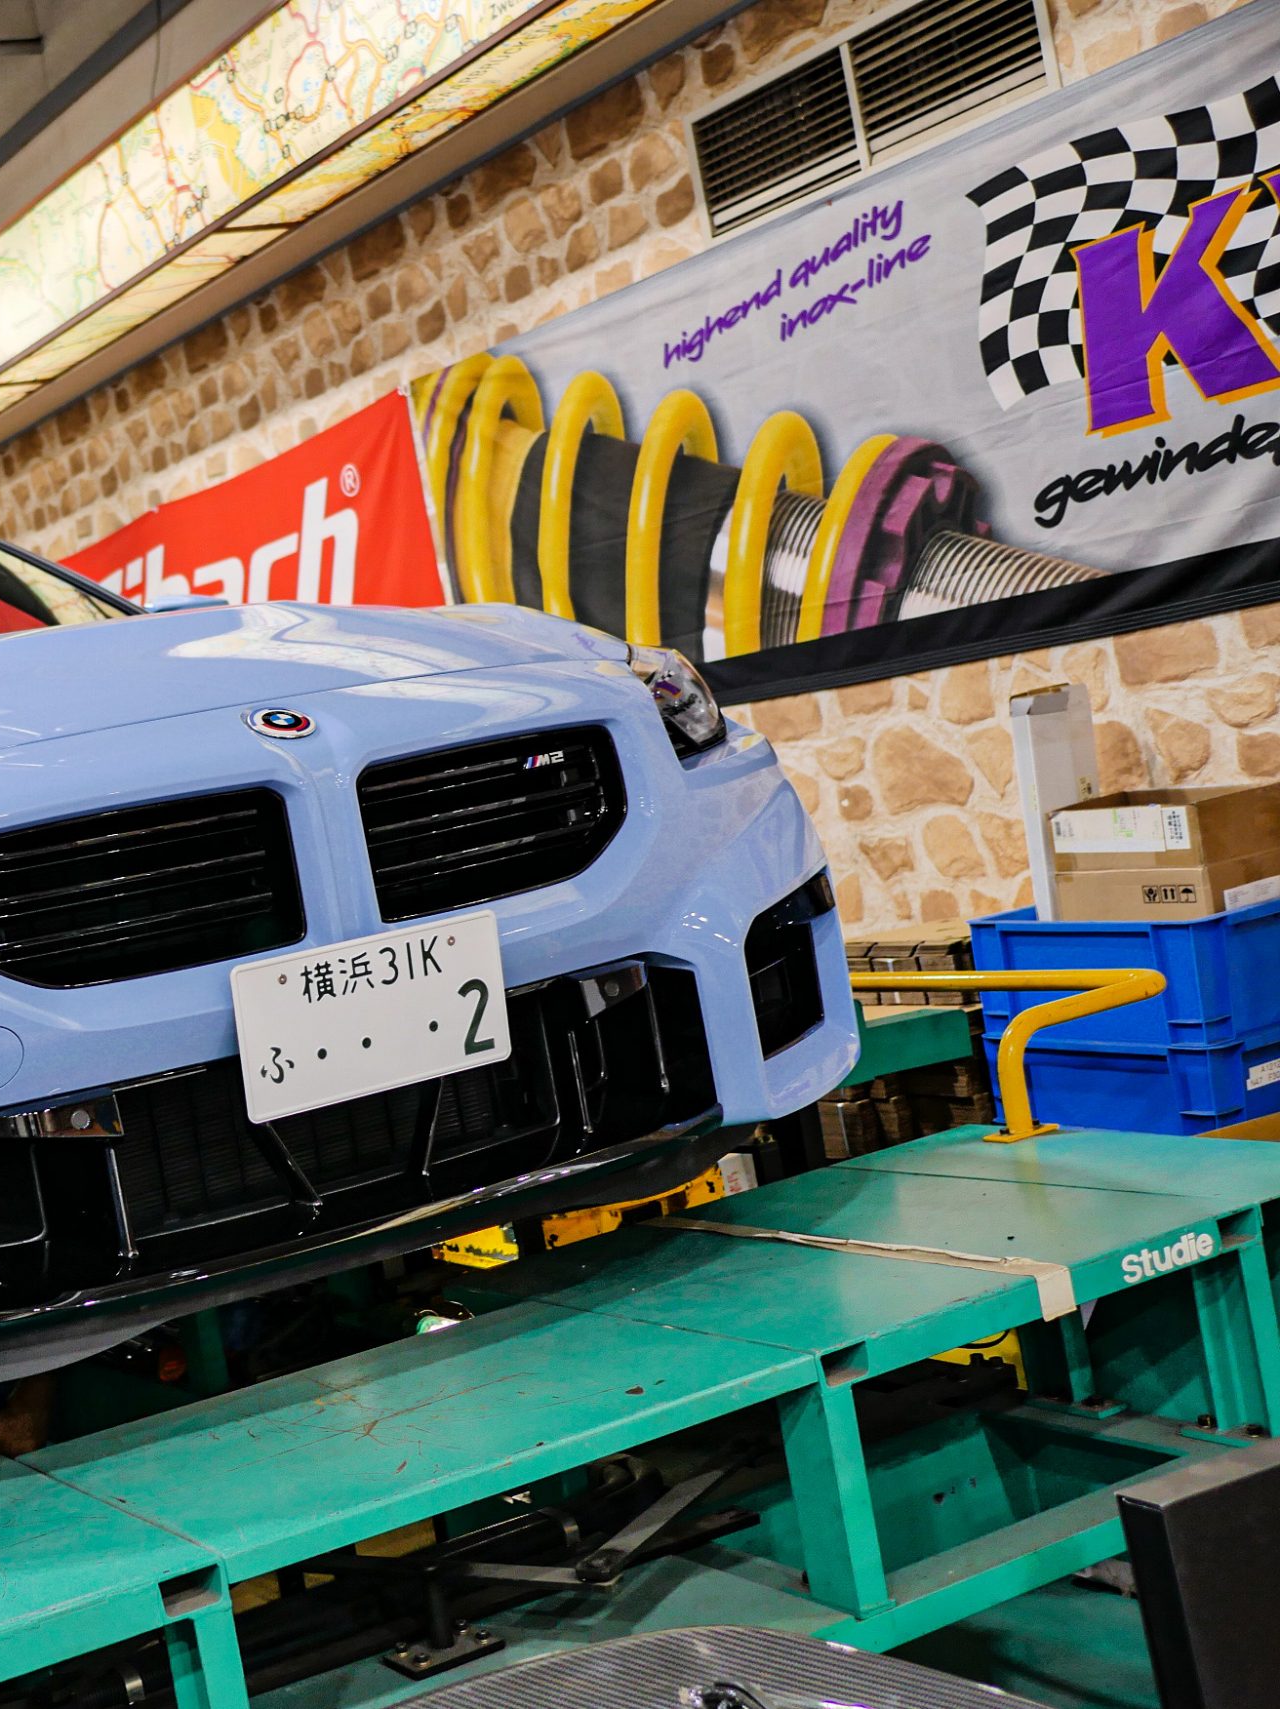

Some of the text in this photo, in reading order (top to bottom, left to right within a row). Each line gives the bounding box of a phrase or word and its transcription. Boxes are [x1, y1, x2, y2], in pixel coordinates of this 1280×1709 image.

[664, 200, 903, 369] highend quality
[780, 234, 931, 341] inox-line
[1069, 168, 1280, 438] K
[96, 477, 359, 607] bach
[1122, 1232, 1213, 1283] Studie
